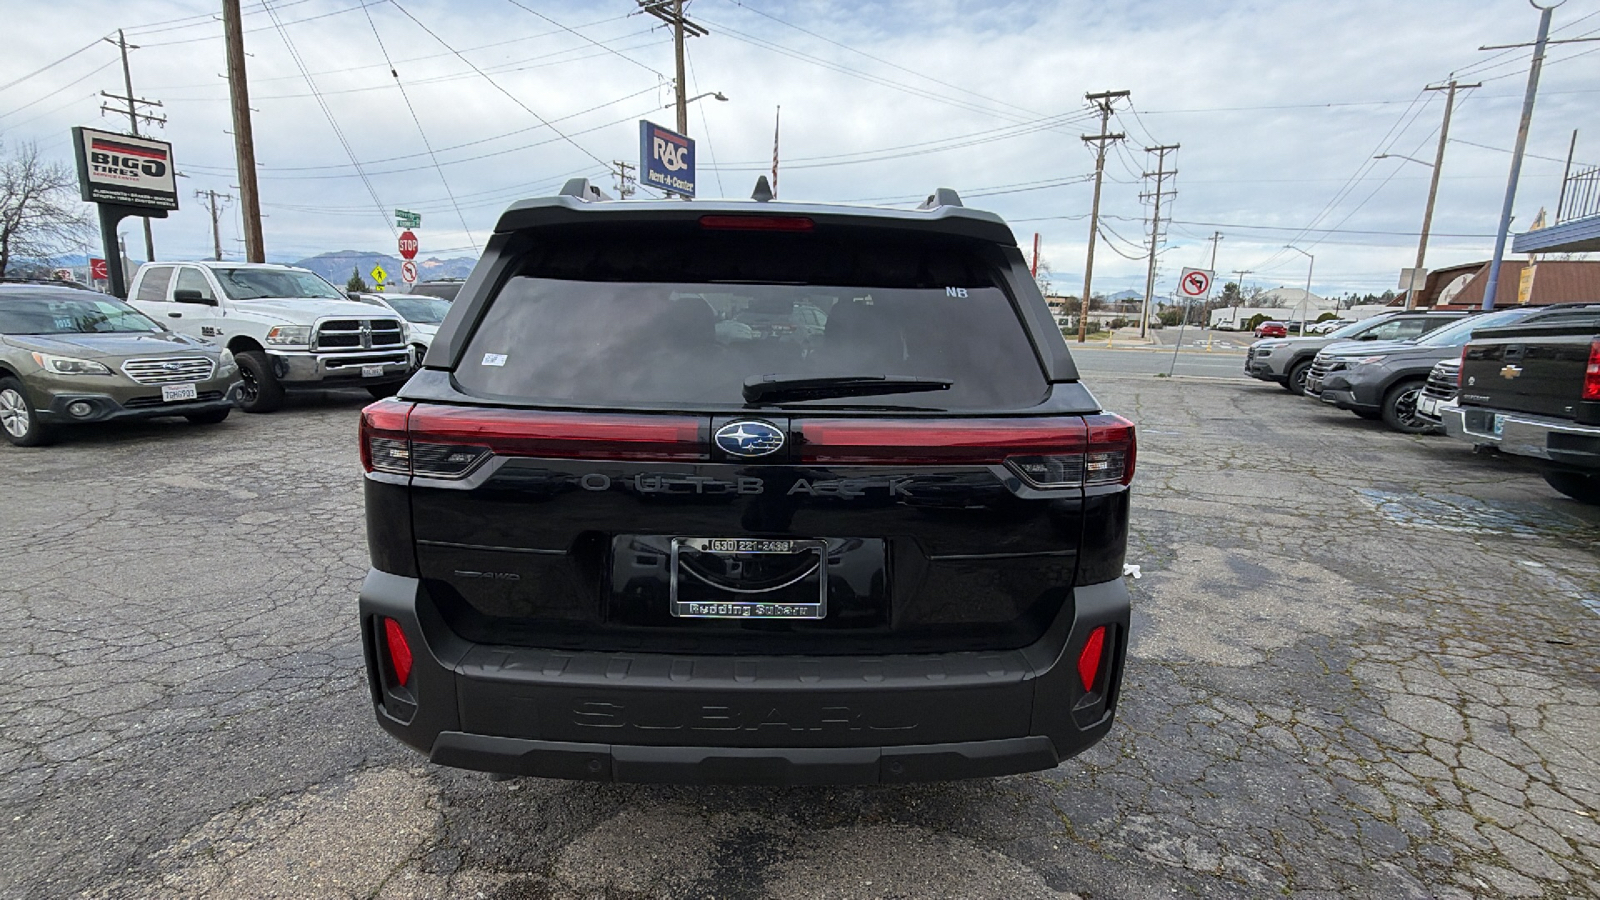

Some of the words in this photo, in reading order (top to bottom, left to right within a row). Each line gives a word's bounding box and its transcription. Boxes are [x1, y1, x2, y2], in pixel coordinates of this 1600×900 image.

[653, 136, 688, 171] RAC
[92, 152, 139, 170] BIG
[92, 164, 139, 177] TIRES
[400, 240, 417, 250] STOP
[945, 286, 968, 298] NB
[581, 473, 914, 497] OUTBACK
[711, 540, 737, 551] (530)
[755, 604, 808, 616] Subaru
[572, 698, 919, 731] SUBARU
